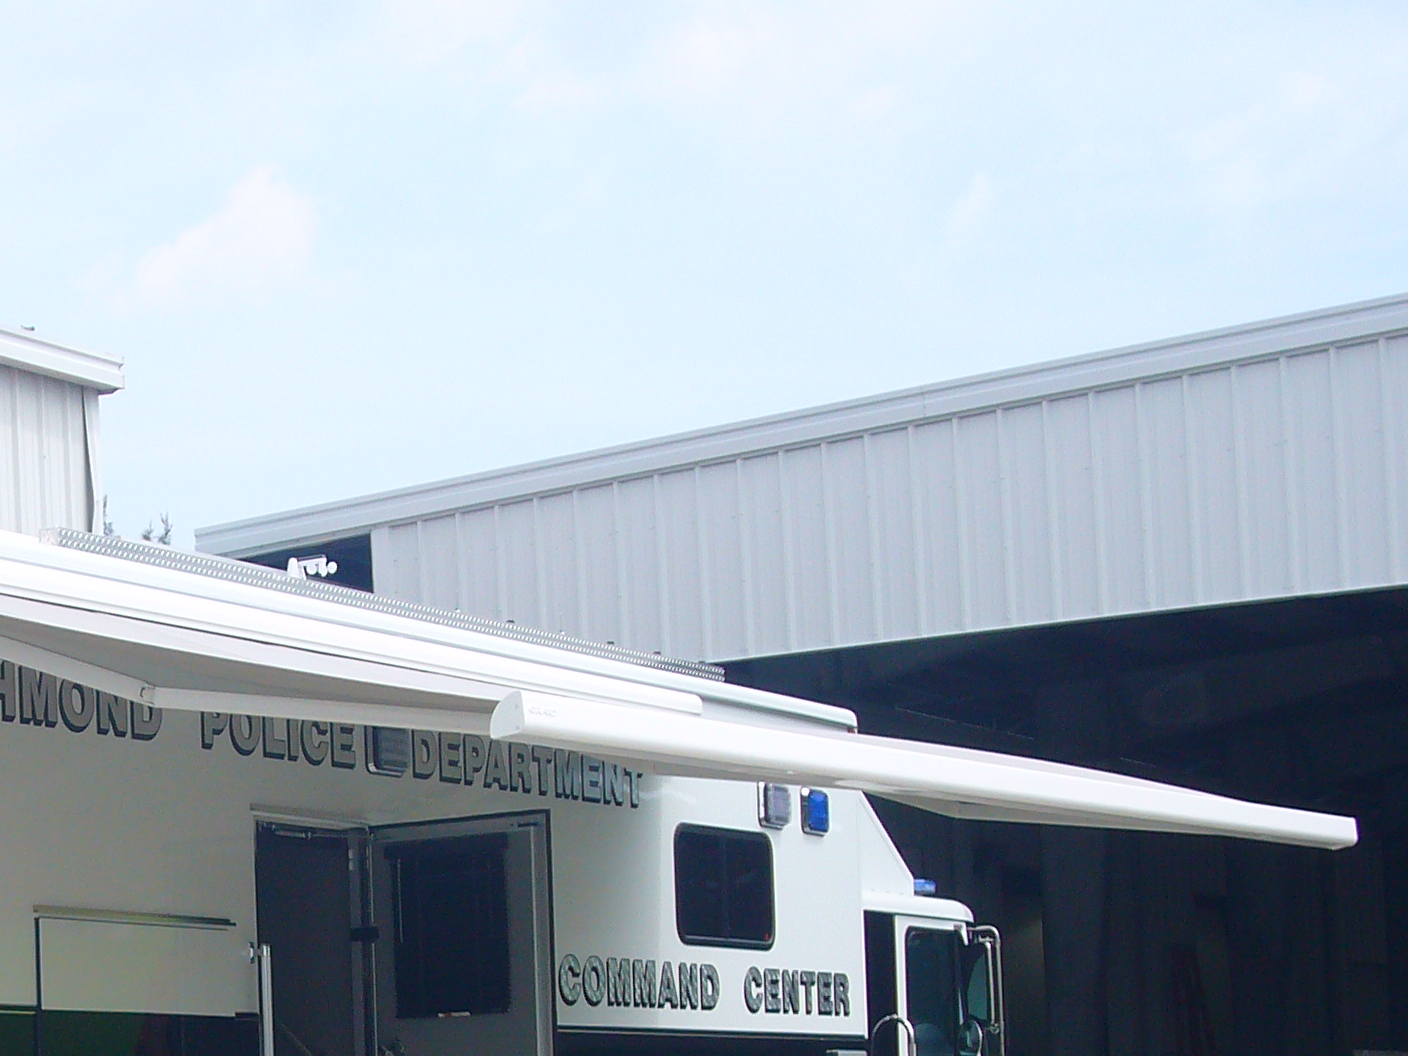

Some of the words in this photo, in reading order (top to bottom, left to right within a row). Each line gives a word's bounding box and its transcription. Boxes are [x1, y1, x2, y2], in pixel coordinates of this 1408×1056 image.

[200, 711, 357, 770] POLICE
[410, 729, 643, 809] DEPARTMENT
[559, 953, 720, 1011] COMMAND
[744, 966, 851, 1017] CENTER
